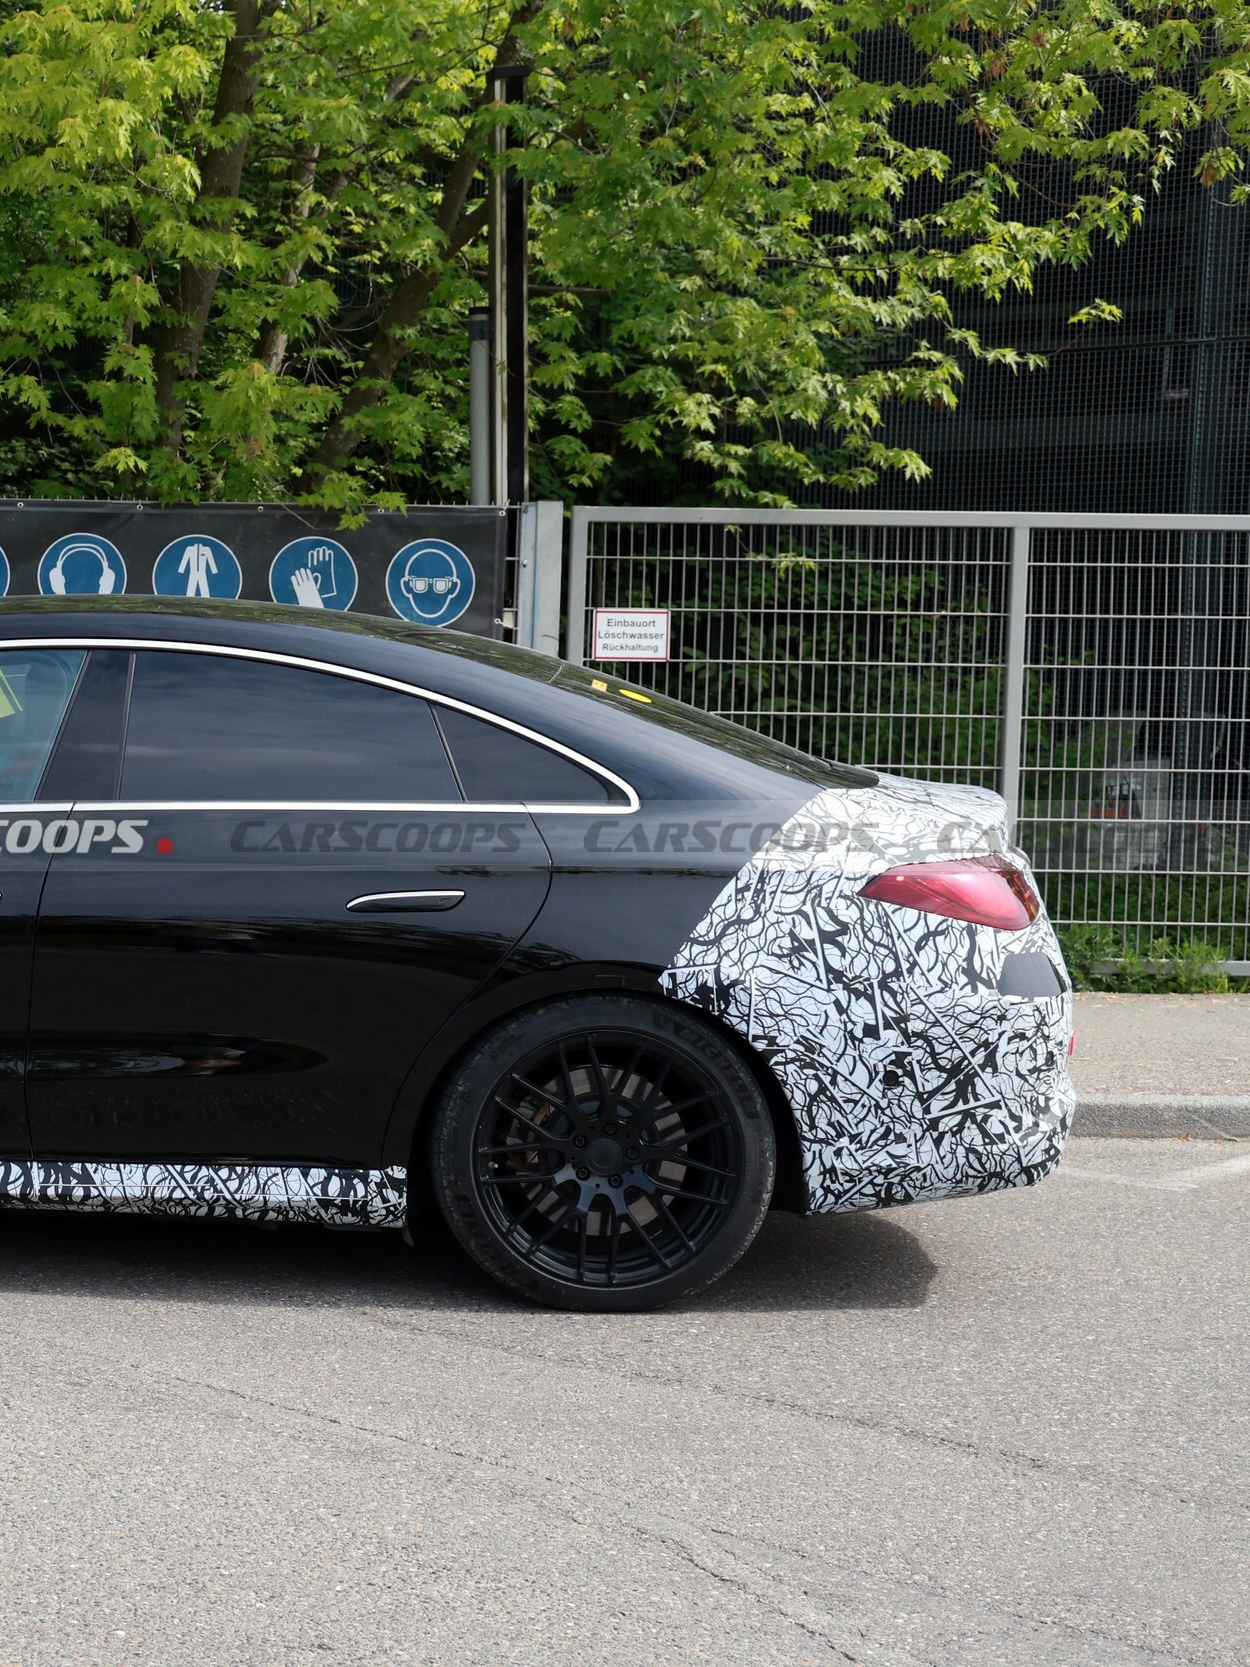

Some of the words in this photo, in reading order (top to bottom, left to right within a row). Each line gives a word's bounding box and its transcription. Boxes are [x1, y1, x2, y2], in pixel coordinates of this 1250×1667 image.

[606, 618, 656, 628] Einbauort
[597, 630, 665, 640] Löschwasser
[602, 643, 659, 653] Rückhaltung
